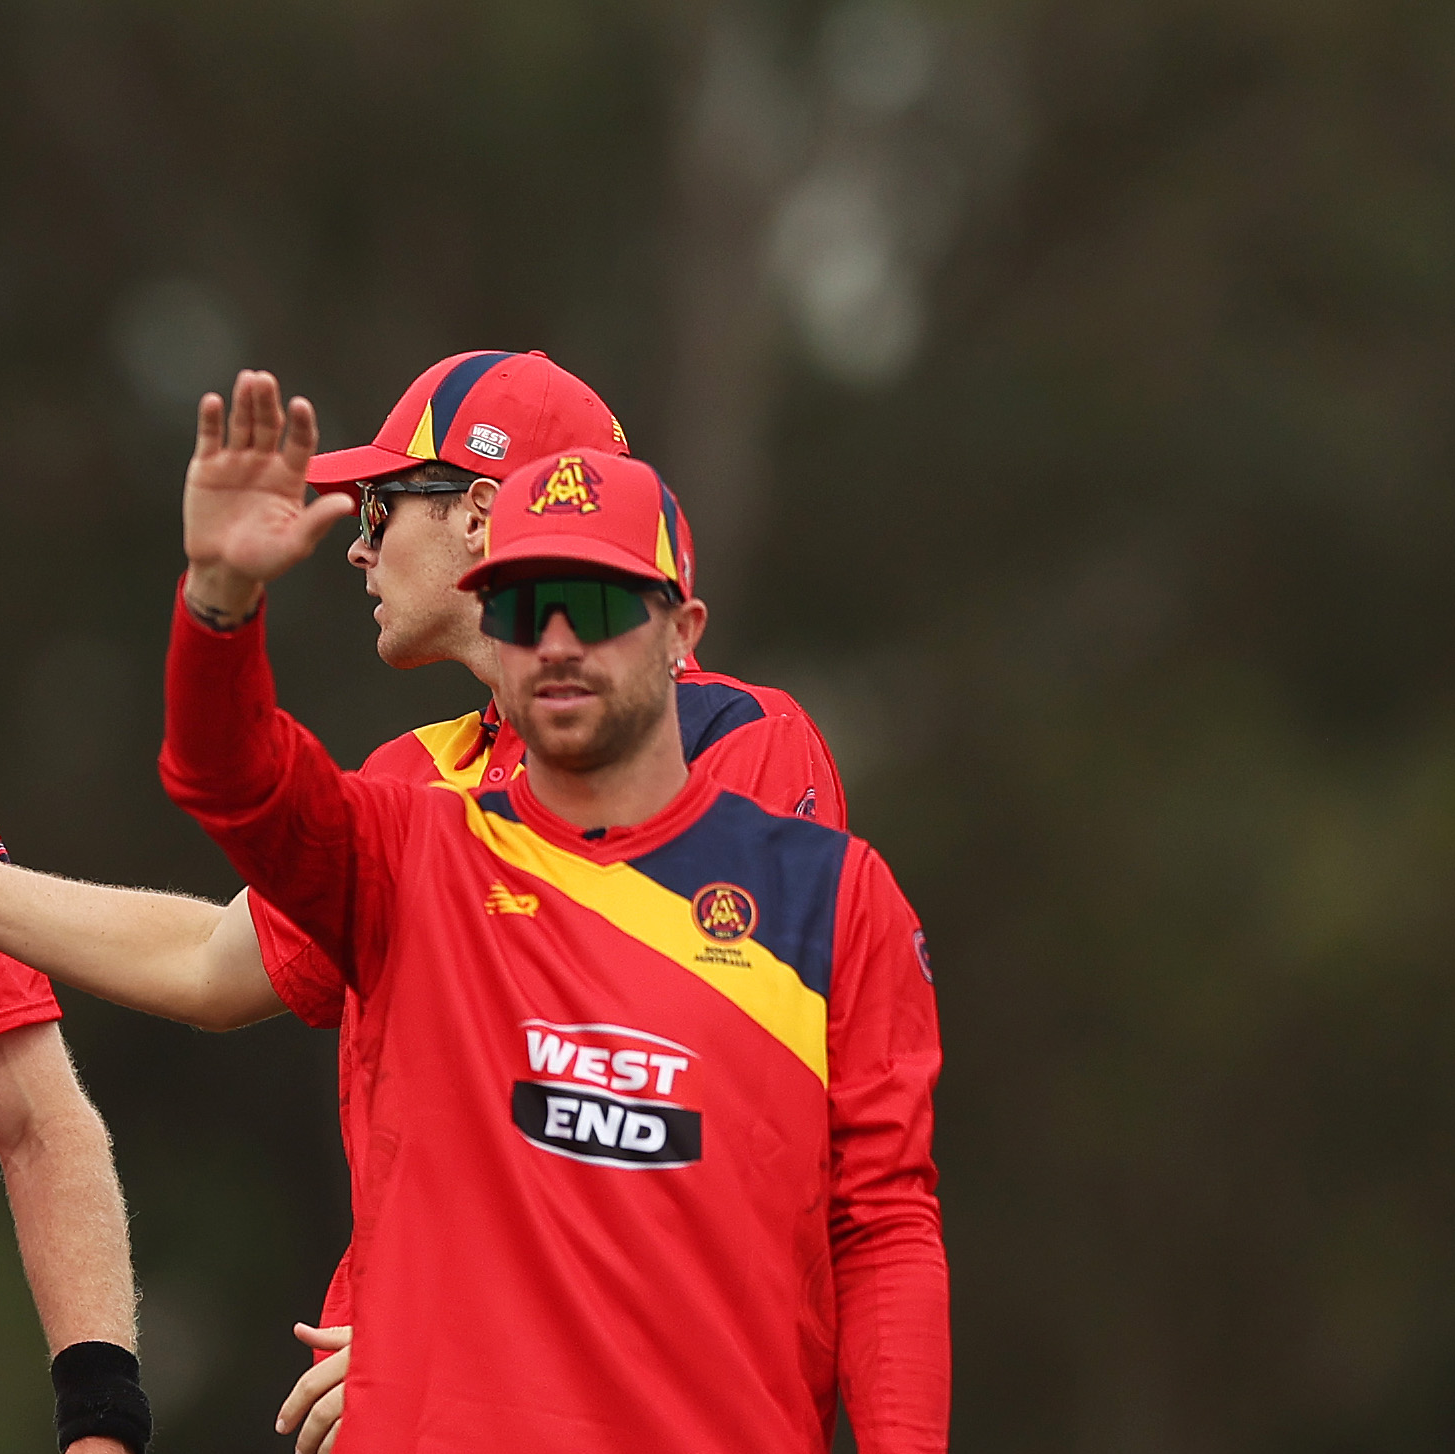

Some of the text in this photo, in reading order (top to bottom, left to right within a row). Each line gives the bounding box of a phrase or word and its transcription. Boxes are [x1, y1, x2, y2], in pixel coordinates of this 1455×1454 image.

[470, 438, 499, 456] END
[472, 425, 507, 444] WEST
[525, 1029, 689, 1096] WEST
[544, 1095, 667, 1153] END
